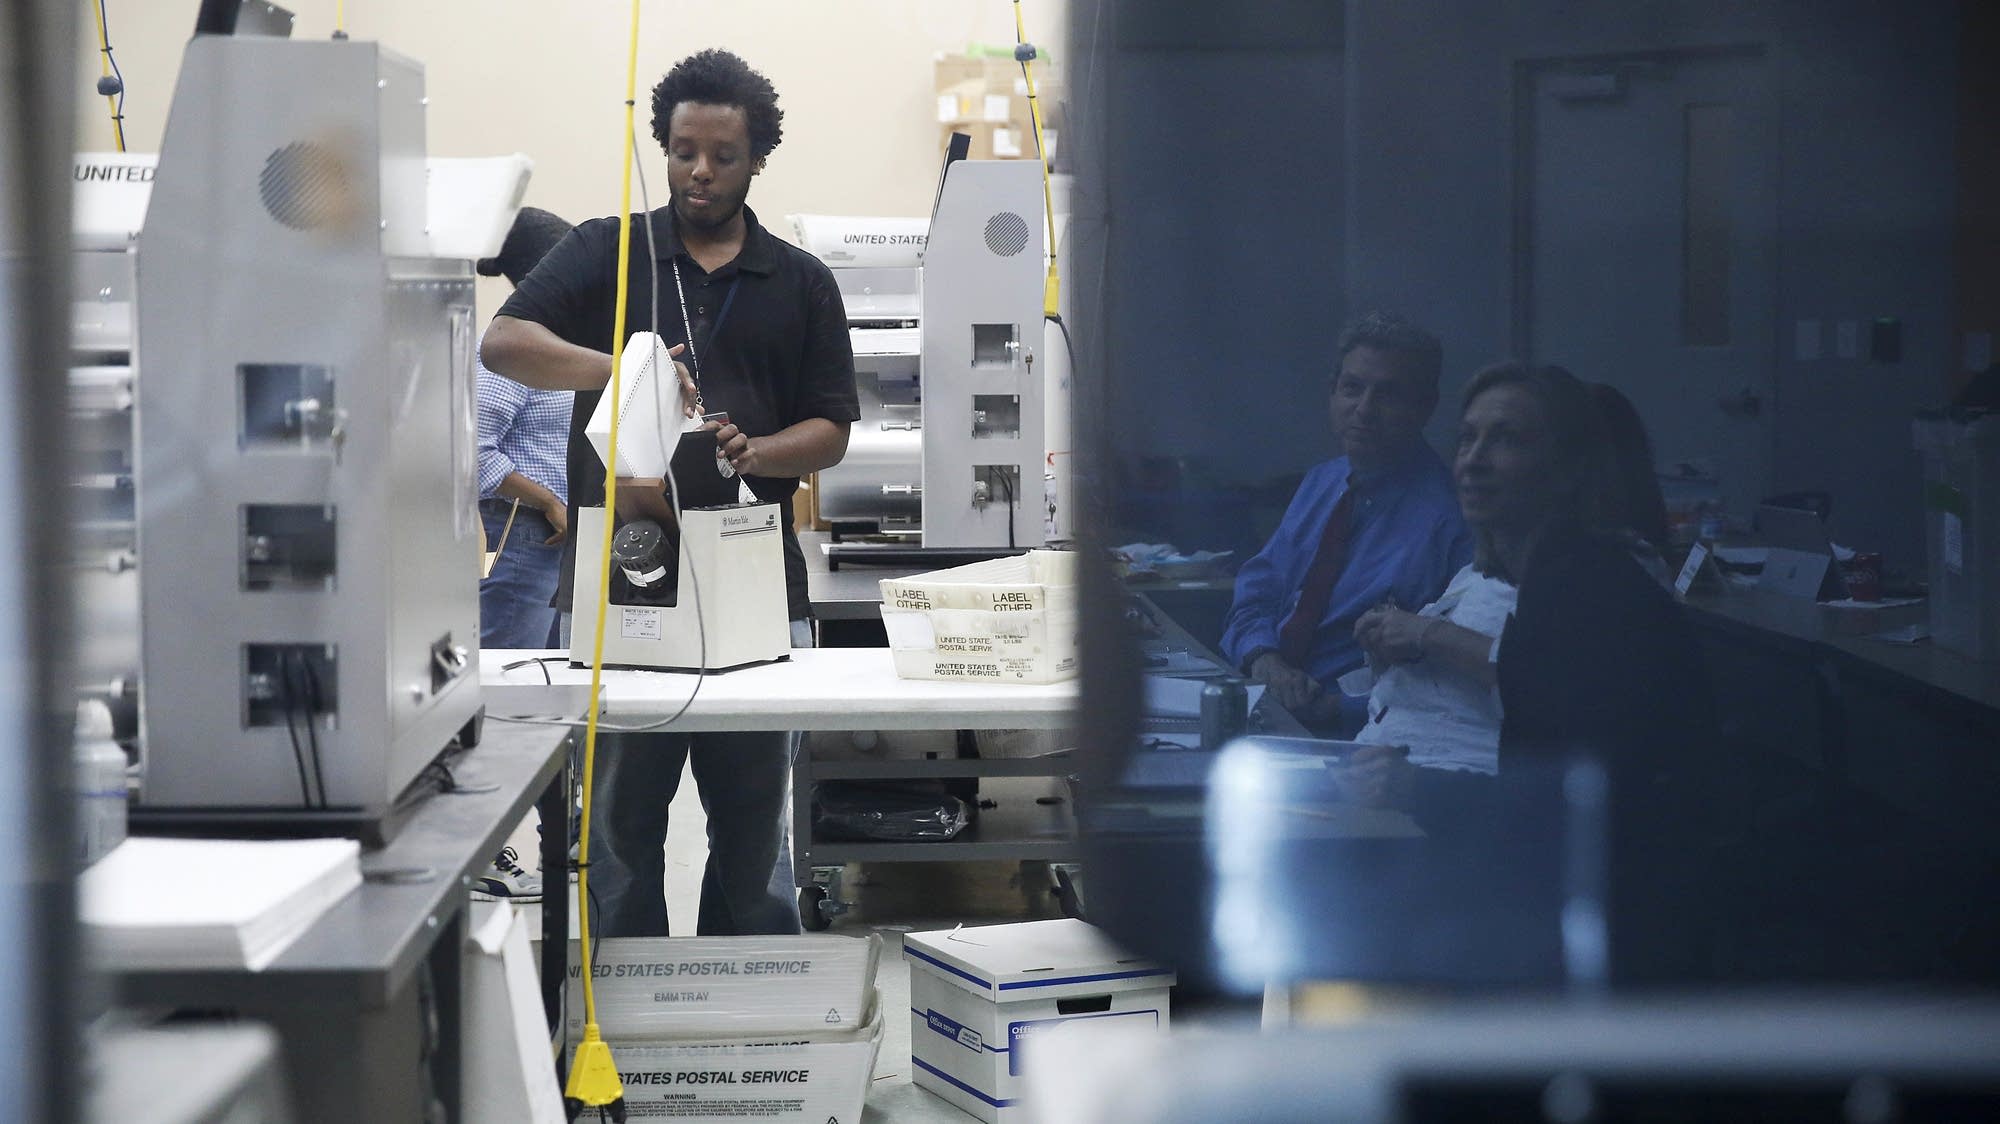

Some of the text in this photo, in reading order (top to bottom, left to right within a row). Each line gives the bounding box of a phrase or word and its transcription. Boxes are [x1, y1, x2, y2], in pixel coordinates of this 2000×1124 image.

[74, 165, 156, 181] UNITED
[844, 234, 887, 244] UNITED
[741, 514, 749, 524] Yale
[894, 588, 930, 601] LABEL
[992, 592, 1032, 603] LABEL
[896, 600, 932, 610] OTHER
[993, 603, 1033, 611] OTHER
[940, 636, 992, 645] UNITED STATE
[967, 663, 998, 671] STATES
[568, 960, 811, 978] NIED STATES POSTAL SERVICE
[654, 991, 710, 1002] EMM TRAY
[617, 1070, 809, 1085] STATES POSTAL SERVICE
